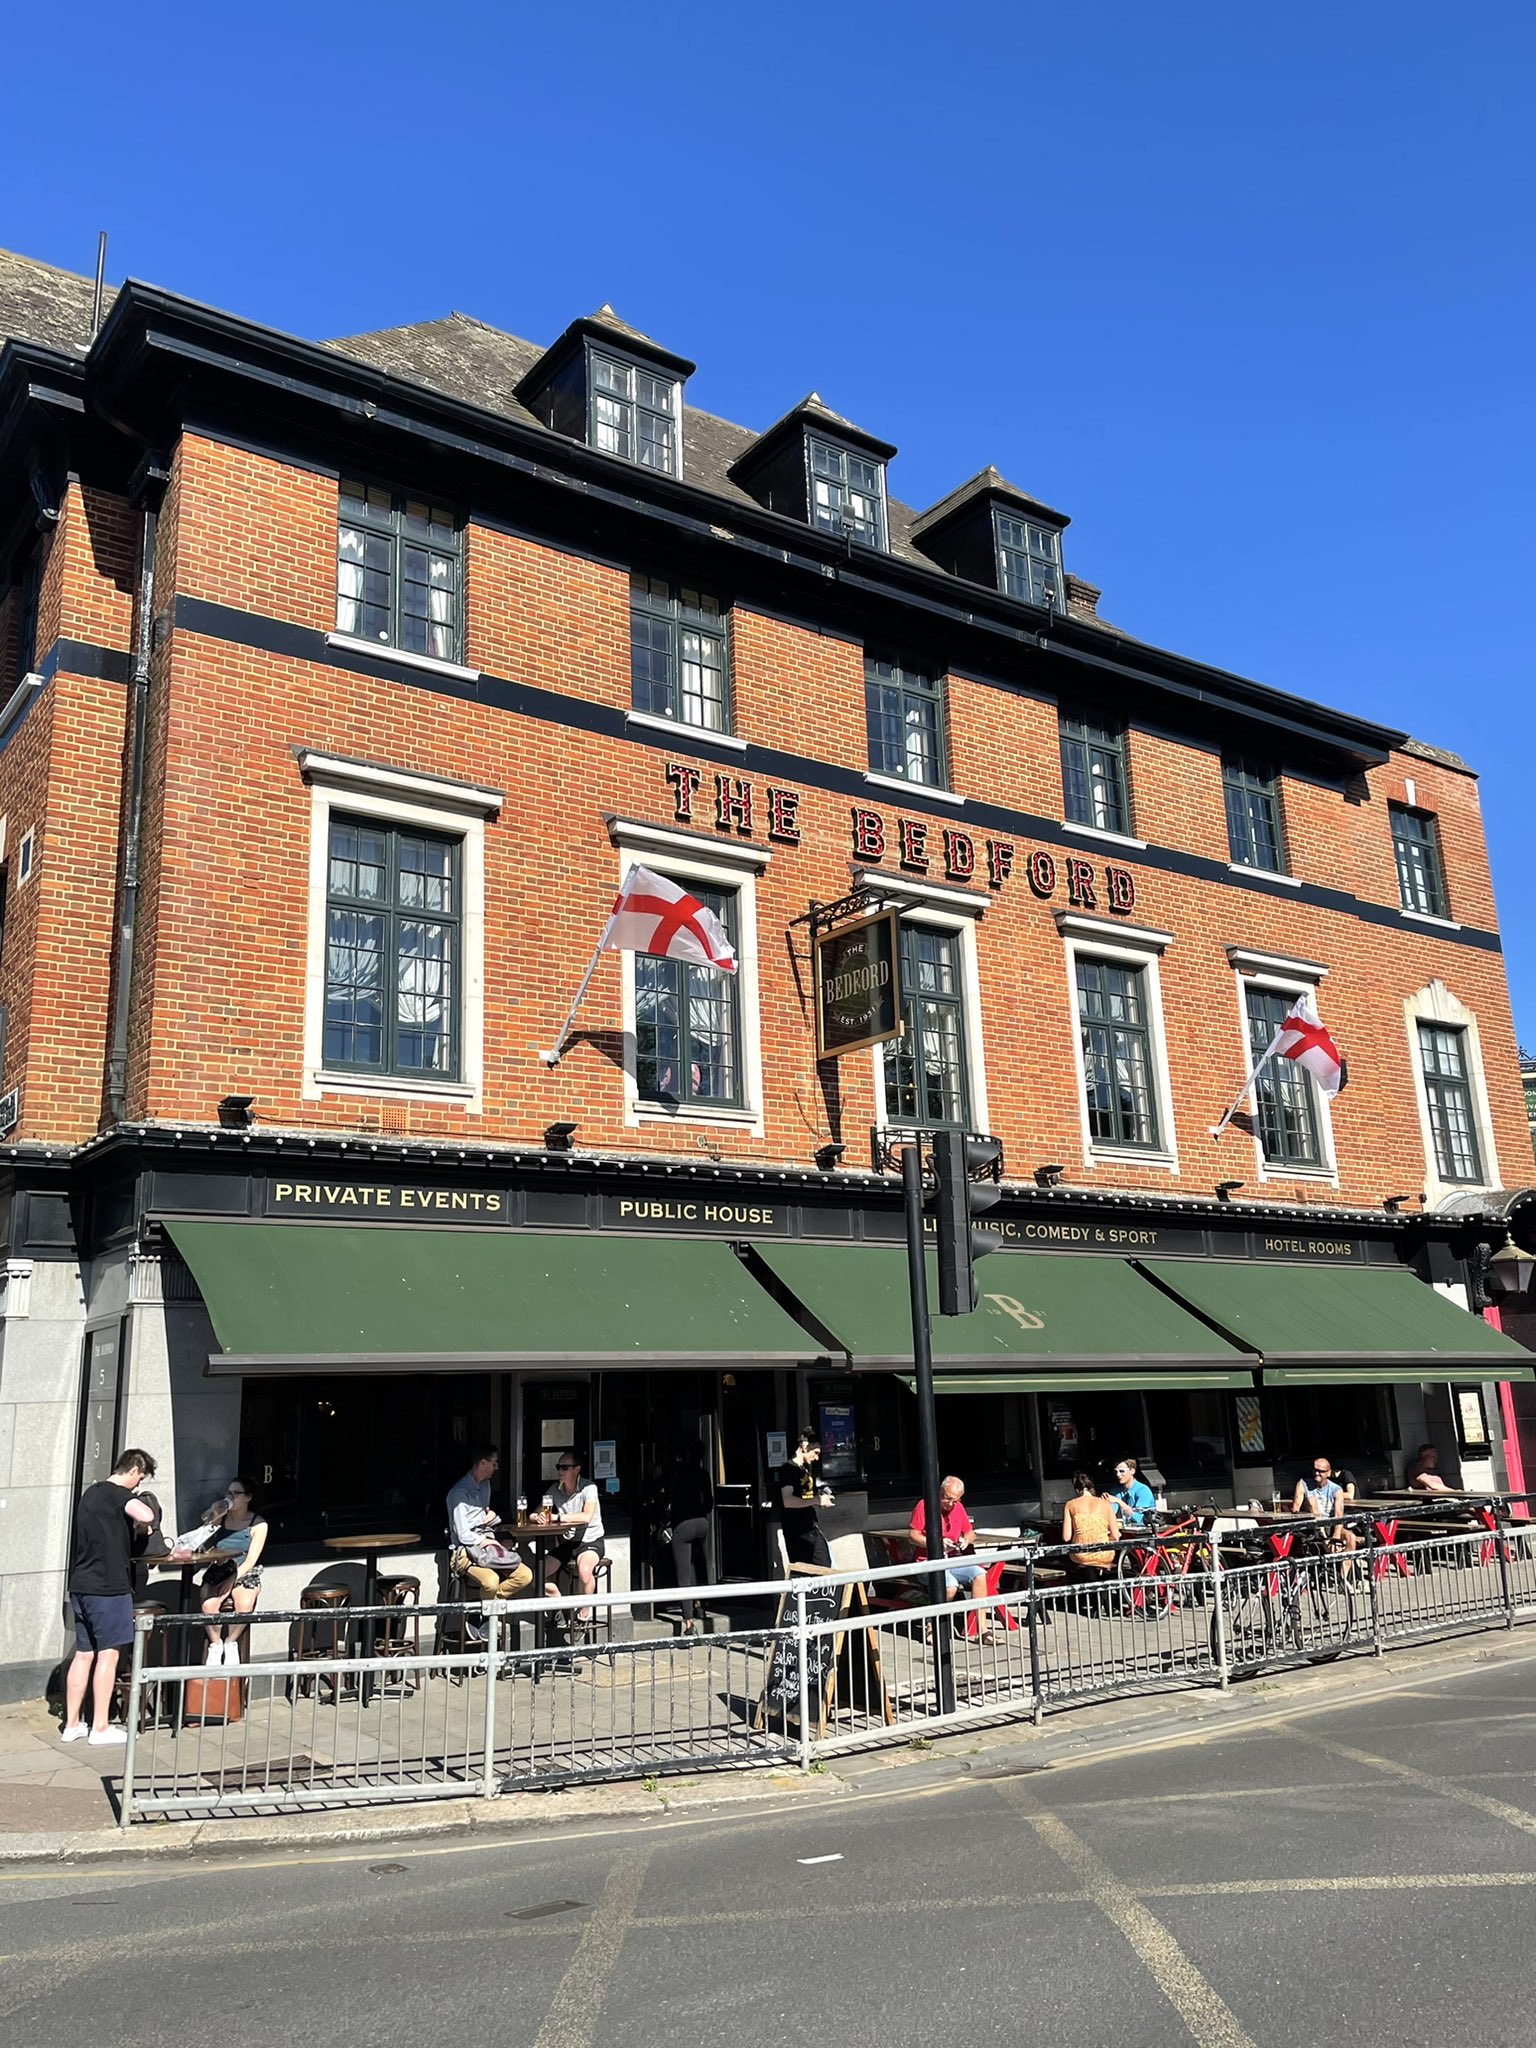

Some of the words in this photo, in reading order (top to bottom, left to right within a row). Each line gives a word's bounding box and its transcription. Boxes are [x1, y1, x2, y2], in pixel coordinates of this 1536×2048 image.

[667, 762, 801, 840] THE
[852, 807, 1137, 914] BEDFORD
[847, 944, 864, 956] THE
[826, 960, 889, 1004] BEDFORD
[859, 1007, 877, 1024] 1931
[275, 1184, 391, 1206] PRIVATE
[400, 1189, 501, 1211] EVENTS
[620, 1201, 697, 1220] PUBLIC
[705, 1206, 773, 1224] HOUSE
[1025, 1224, 1089, 1241] COMEDY
[1095, 1229, 1106, 1242] &
[1109, 1229, 1158, 1244] SPORT
[1264, 1238, 1306, 1253] HOTEL
[1308, 1241, 1352, 1255] ROOMS
[983, 1294, 1045, 1329] B
[99, 1369, 106, 1385] 5
[96, 1404, 103, 1422] 4
[93, 1441, 101, 1459] 3
[263, 1464, 273, 1484] B
